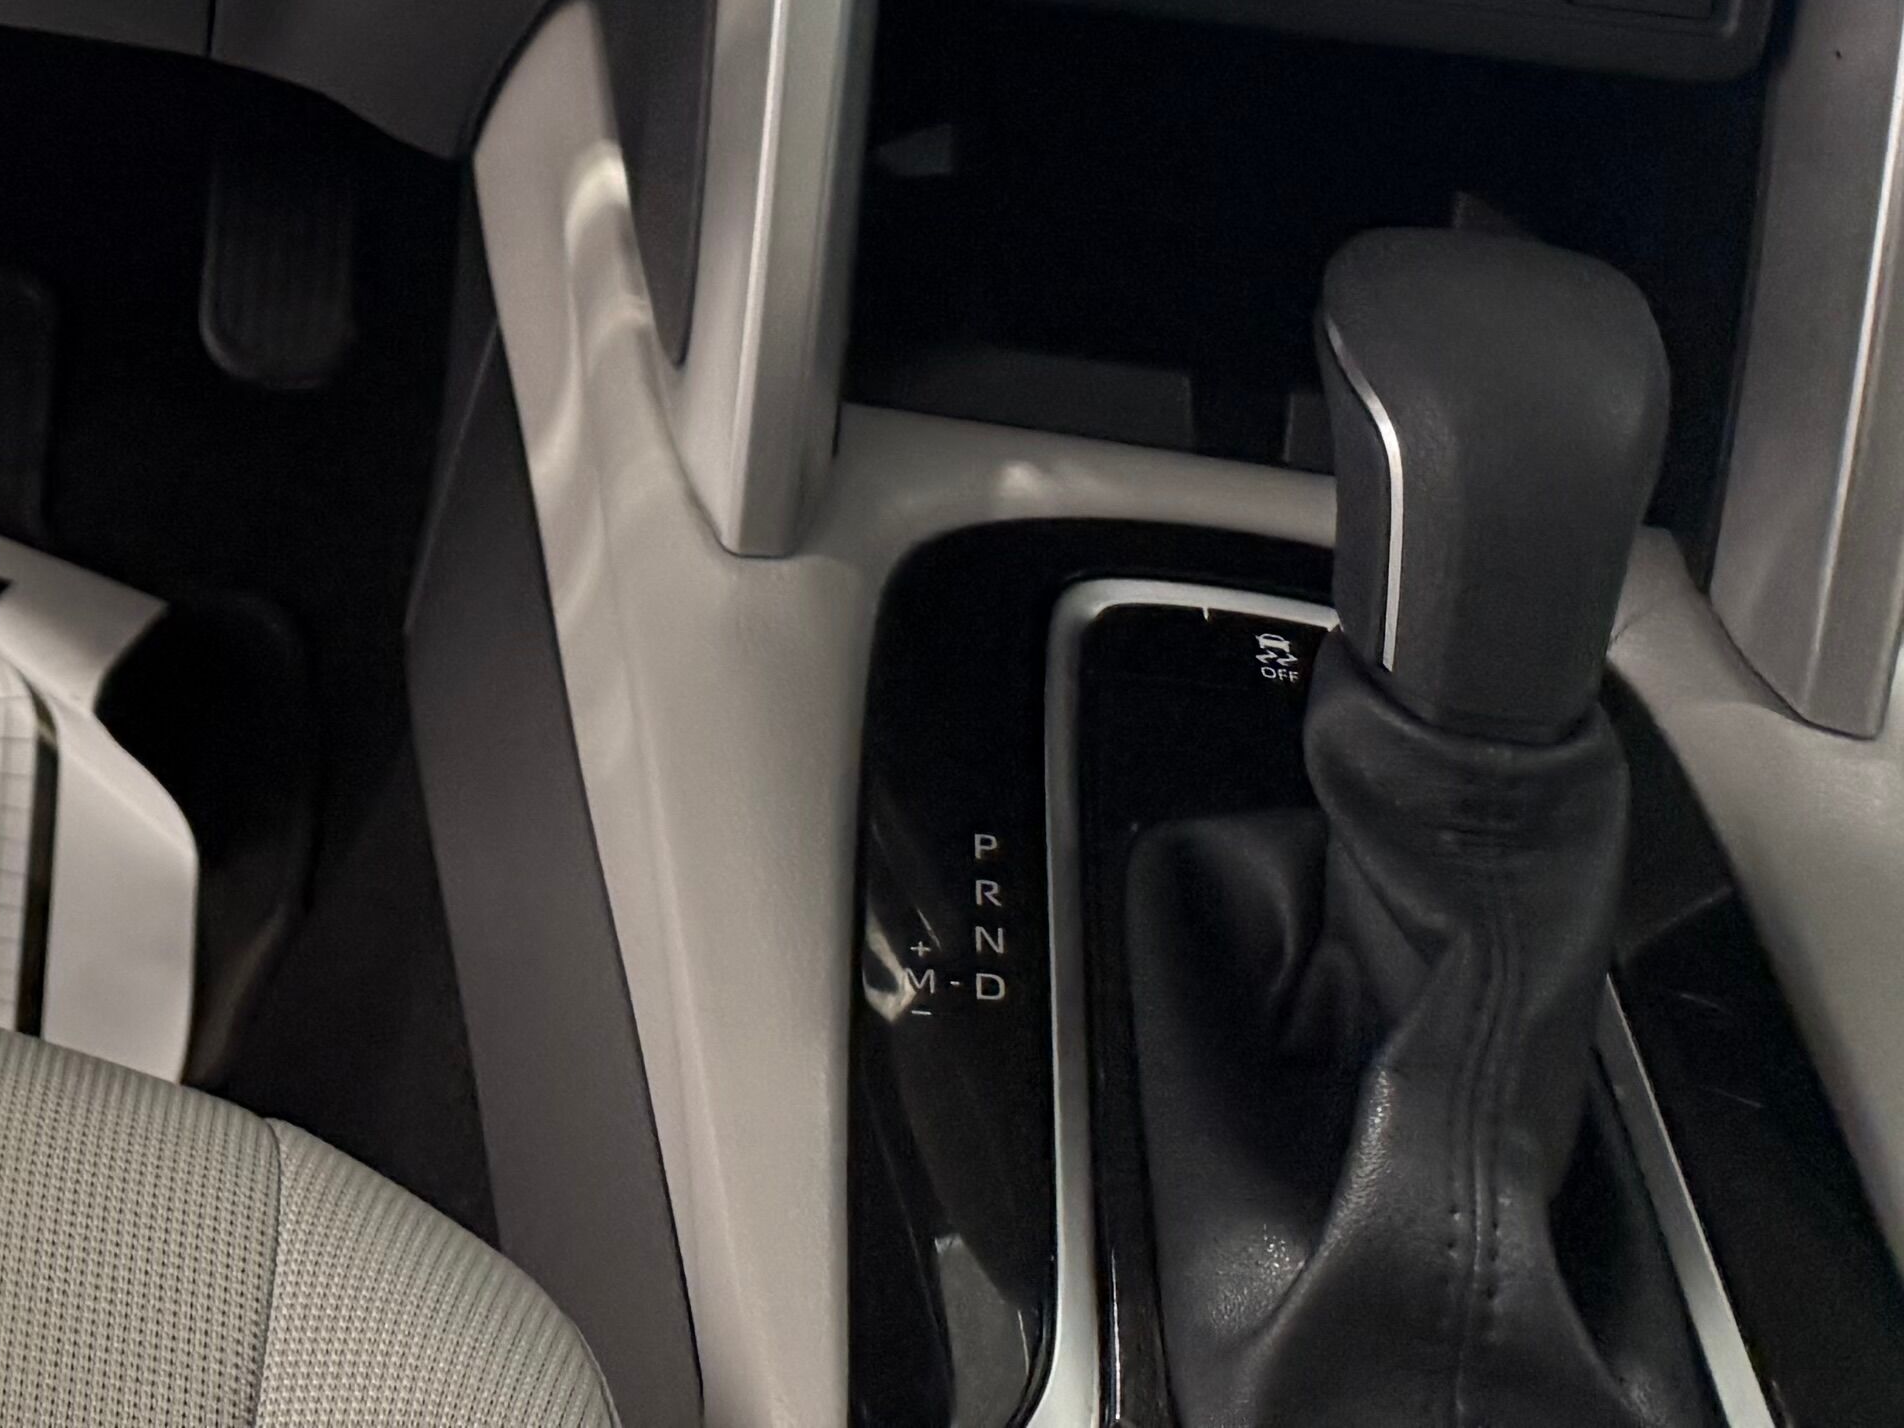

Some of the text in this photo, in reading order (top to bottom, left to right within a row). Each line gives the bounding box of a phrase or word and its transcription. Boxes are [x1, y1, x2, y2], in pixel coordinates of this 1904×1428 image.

[1260, 666, 1300, 683] OFF
[973, 833, 998, 860] P
[975, 880, 1003, 907] R
[975, 927, 1005, 955] N
[904, 969, 1006, 1001] M D
